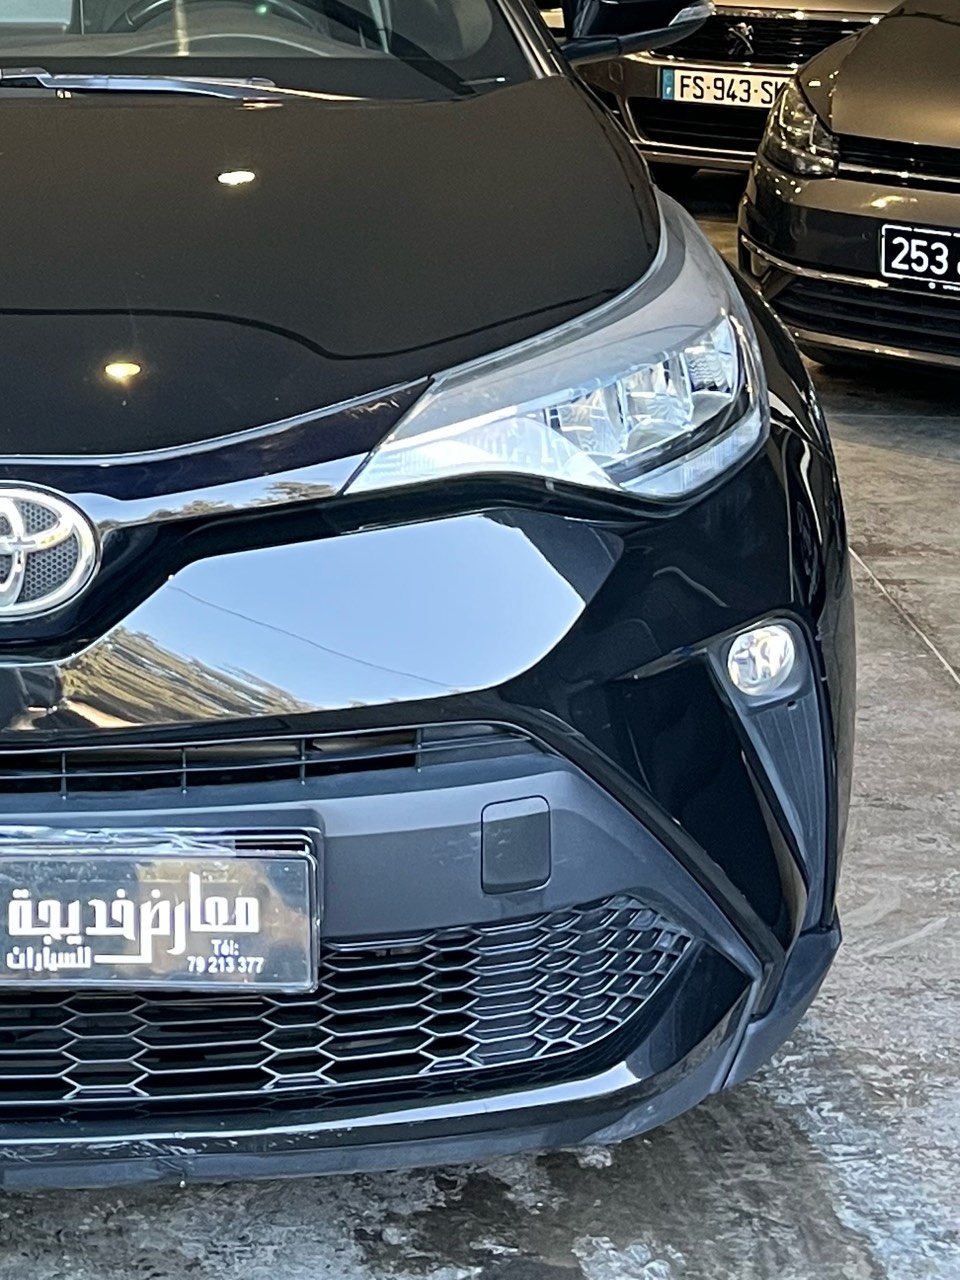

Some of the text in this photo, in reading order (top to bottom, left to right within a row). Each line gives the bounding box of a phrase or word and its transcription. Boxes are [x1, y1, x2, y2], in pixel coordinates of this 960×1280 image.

[891, 236, 949, 275] 253
[208, 956, 235, 974] 213
[237, 956, 265, 974] 377
